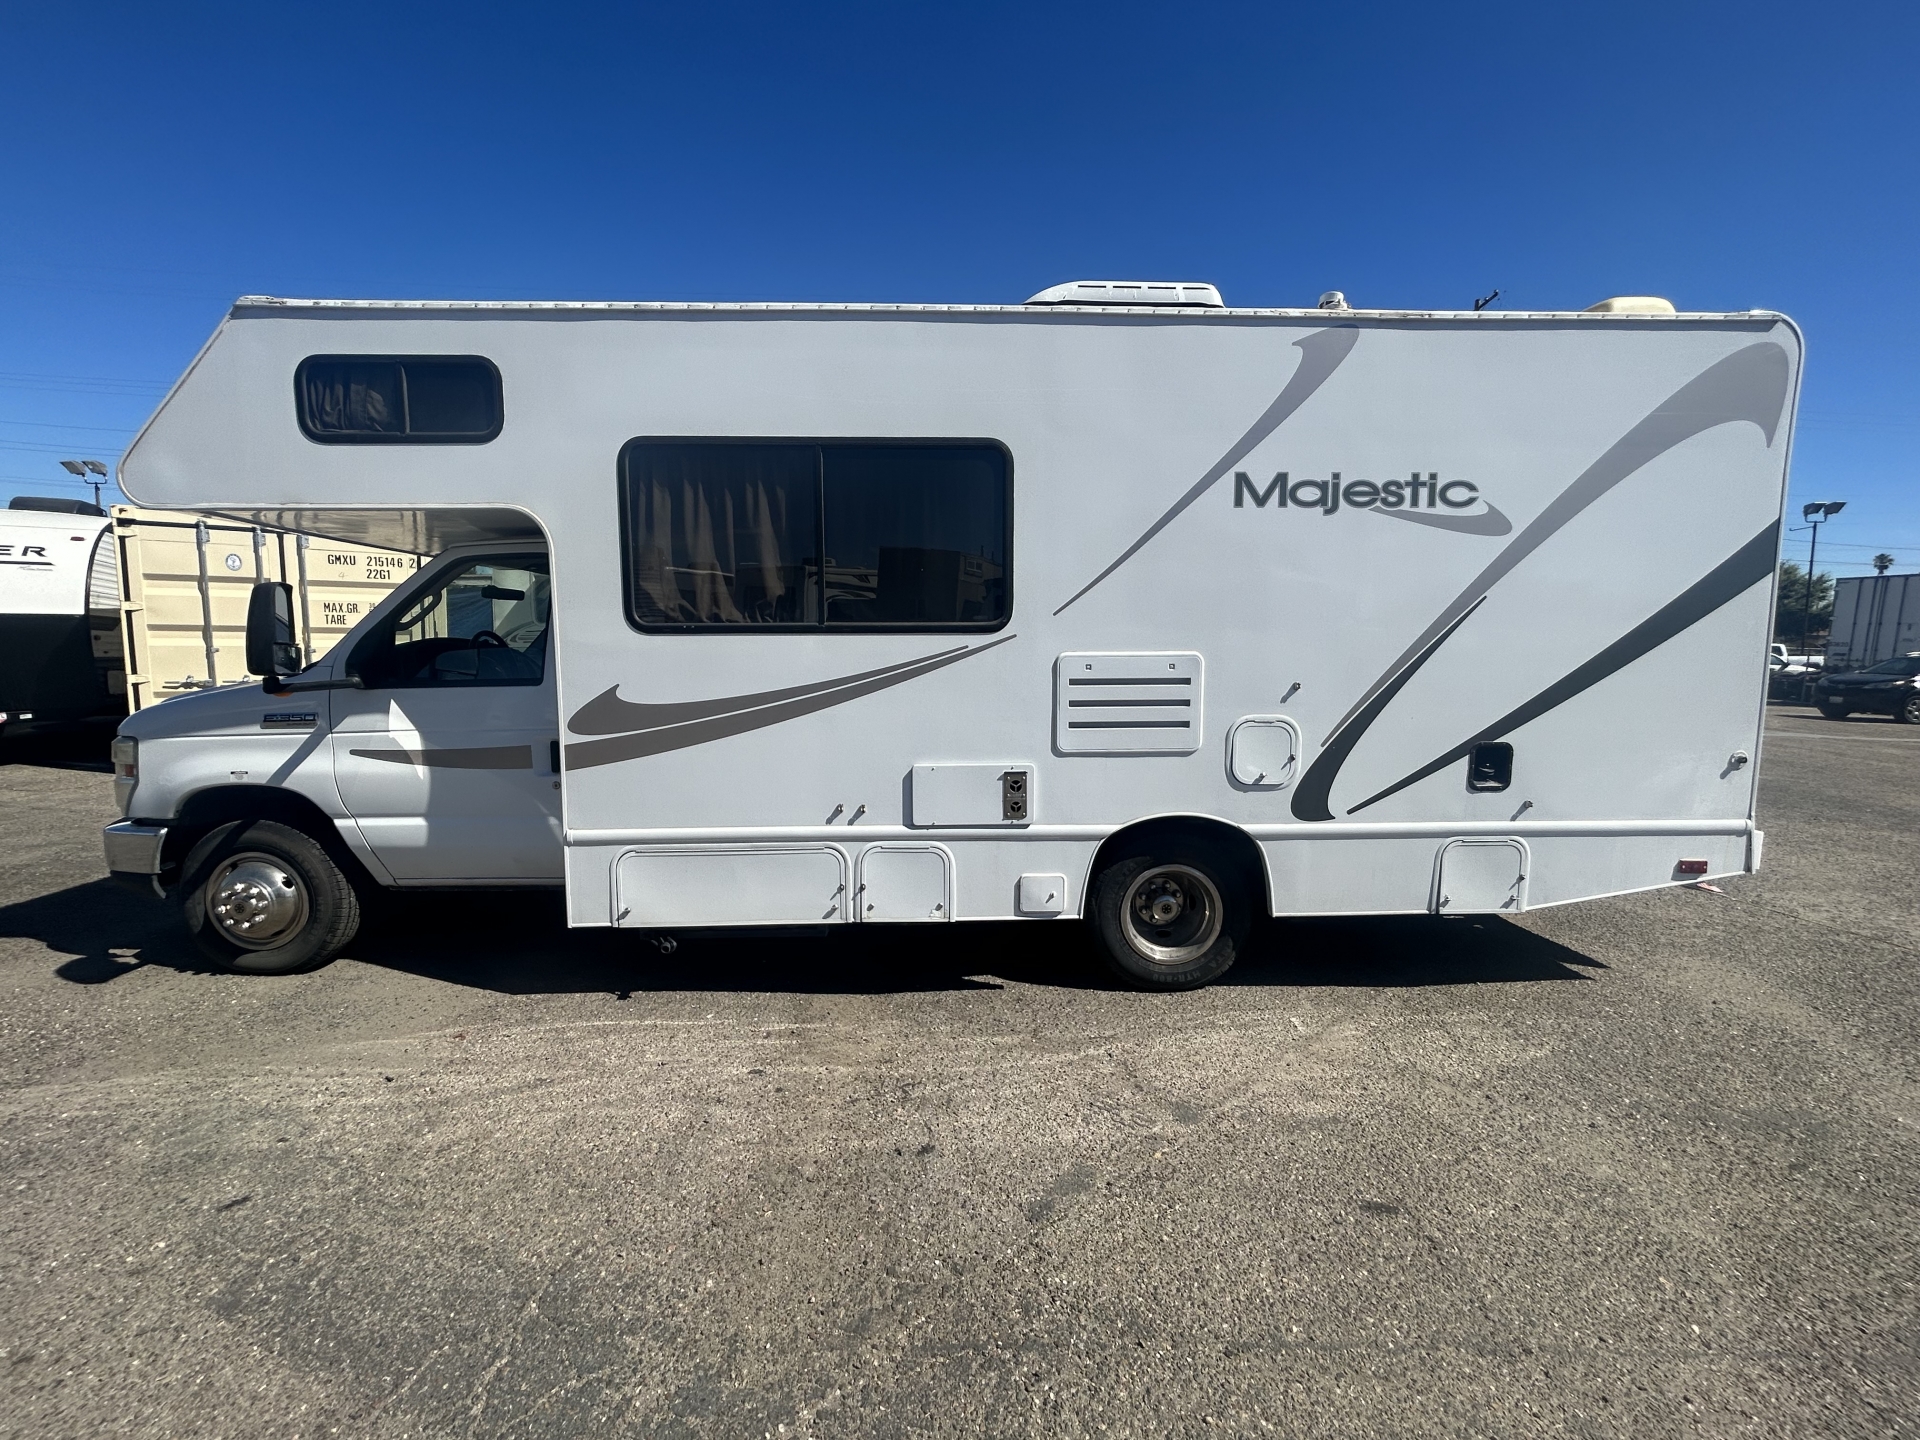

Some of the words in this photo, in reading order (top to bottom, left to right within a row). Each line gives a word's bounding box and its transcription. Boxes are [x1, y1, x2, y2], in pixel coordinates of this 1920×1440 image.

[1233, 471, 1480, 517] Majestic
[327, 554, 356, 566] GMXU
[366, 556, 403, 568] 215146
[366, 569, 391, 580] 22G1
[323, 602, 361, 614] MAX.GR.
[324, 614, 347, 625] TARE
